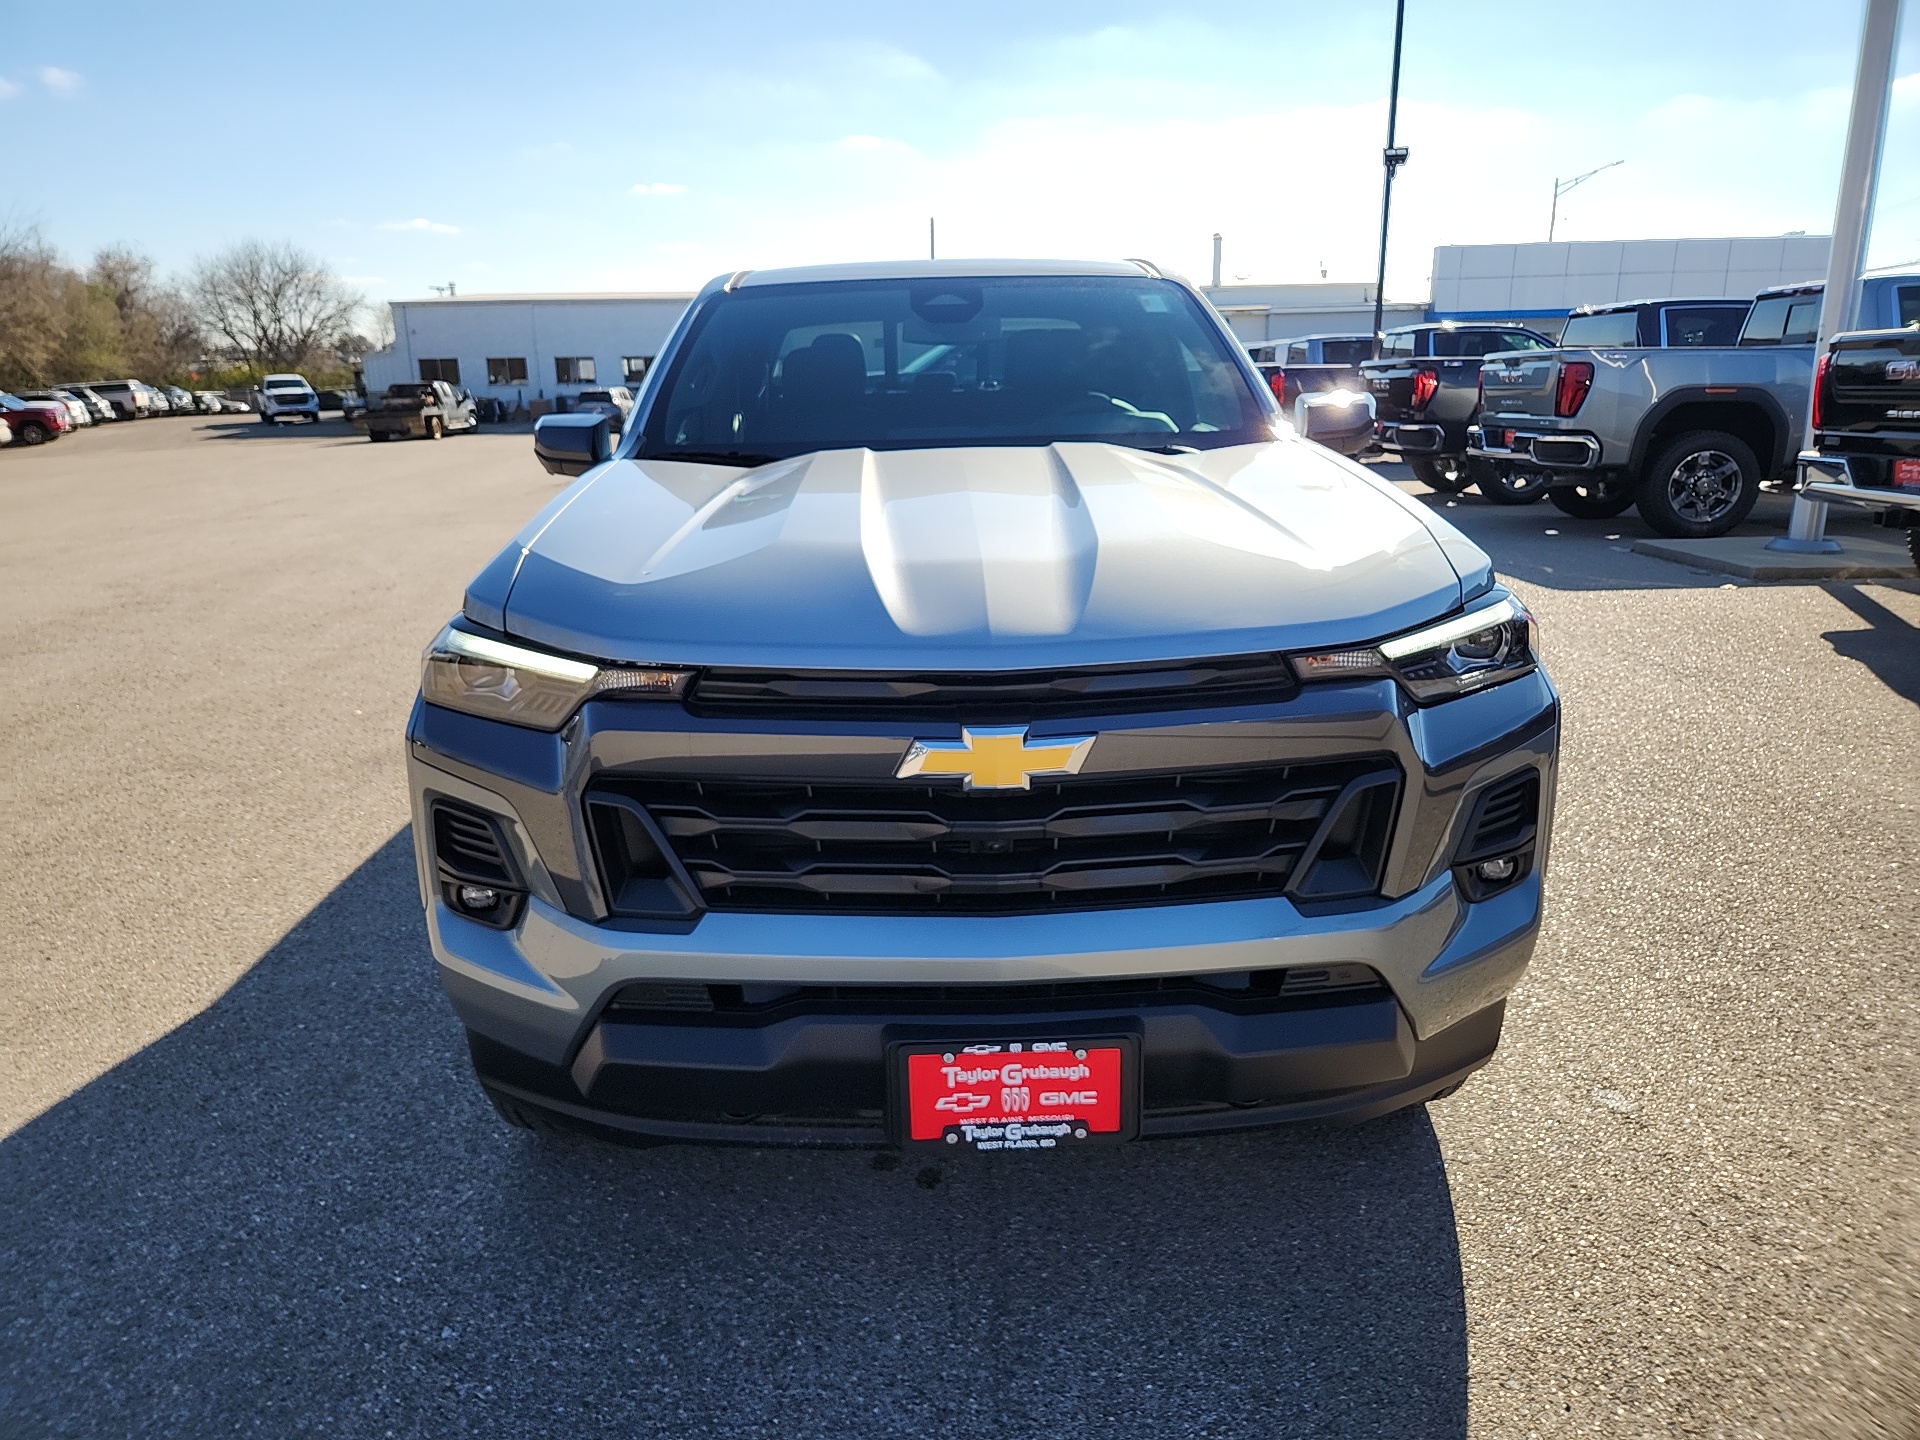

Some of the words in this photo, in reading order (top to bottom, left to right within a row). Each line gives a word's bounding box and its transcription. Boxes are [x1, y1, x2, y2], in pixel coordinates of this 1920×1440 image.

[1031, 1042, 1068, 1053] GMC
[940, 1066, 1000, 1088] Taylor
[1001, 1063, 1091, 1086] Grubaugh
[1039, 1091, 1098, 1106] GMC
[960, 1124, 1005, 1142] Taylor
[1004, 1122, 1072, 1141] Grubaugh
[976, 1141, 1003, 1151] WEST
[1039, 1139, 1057, 1148] MO
